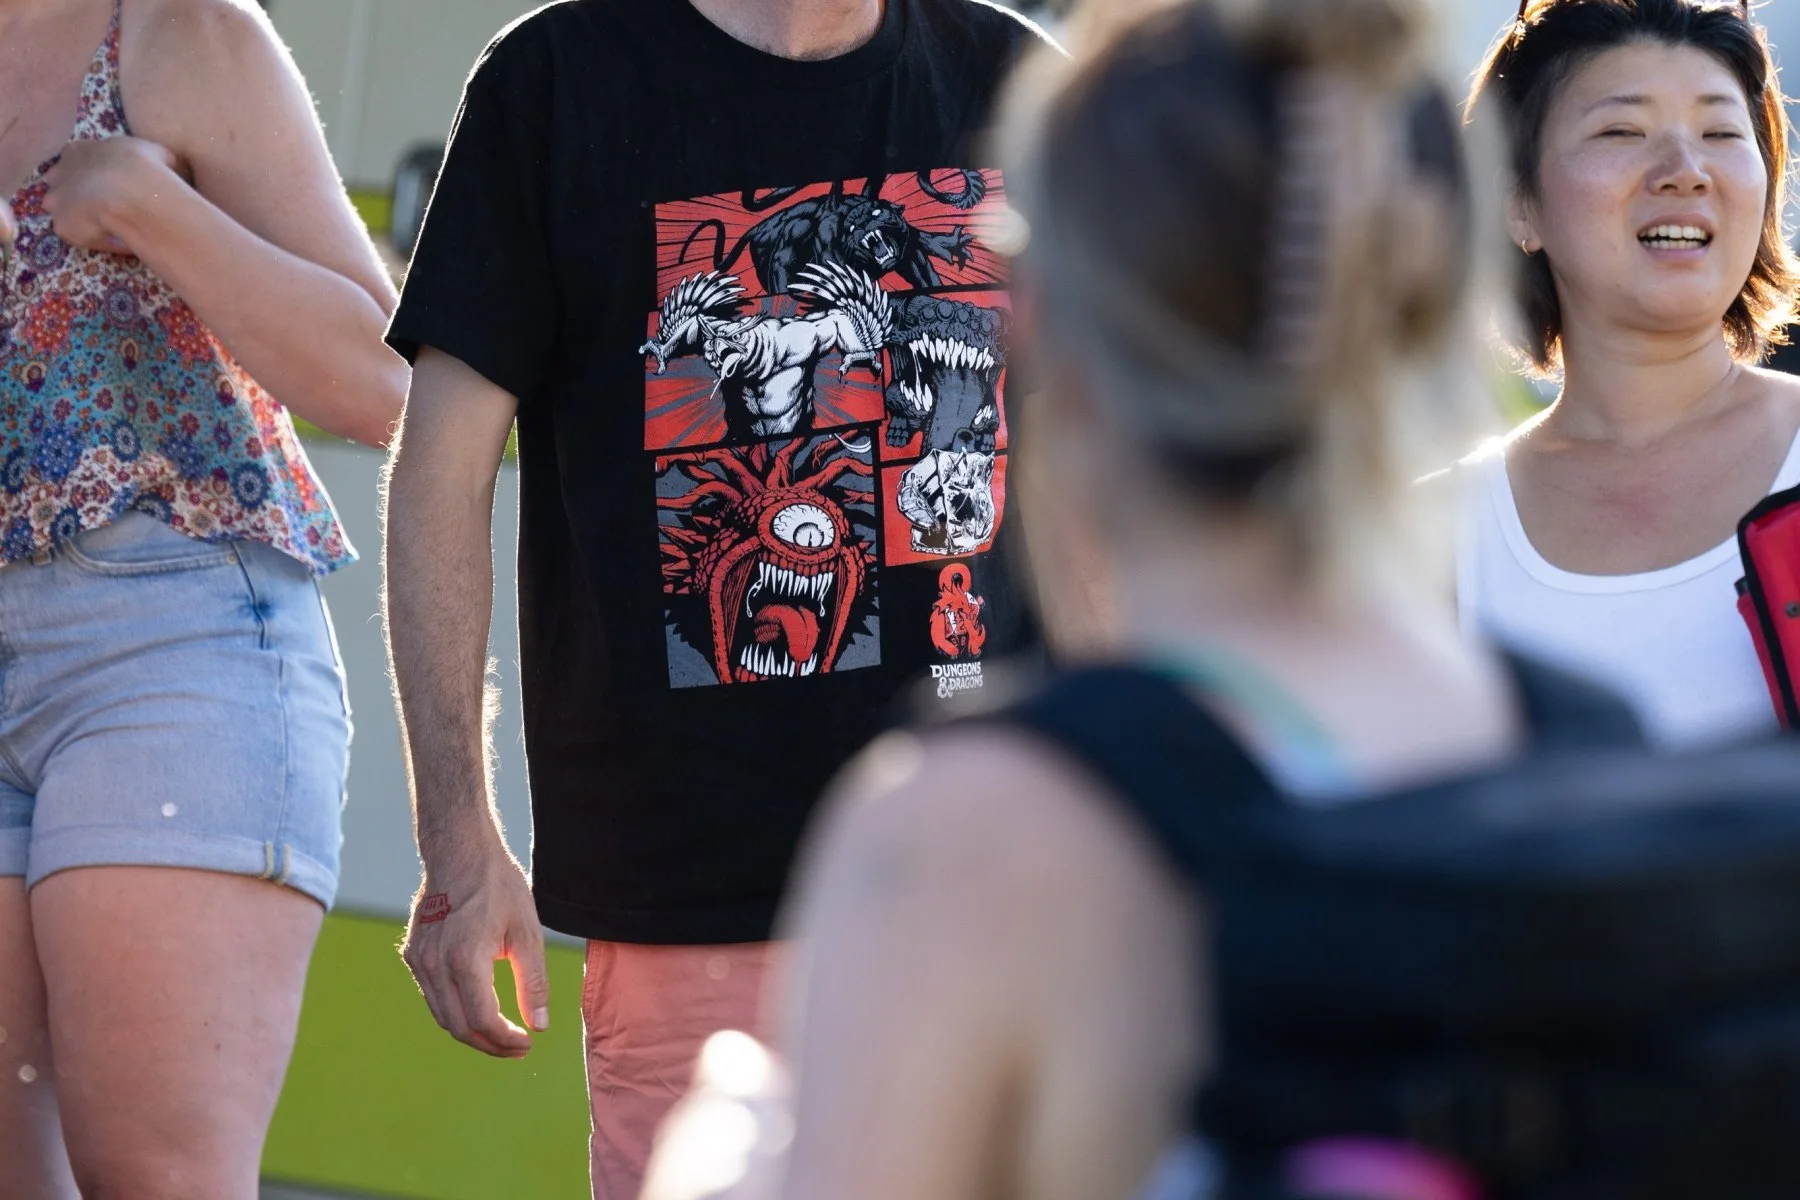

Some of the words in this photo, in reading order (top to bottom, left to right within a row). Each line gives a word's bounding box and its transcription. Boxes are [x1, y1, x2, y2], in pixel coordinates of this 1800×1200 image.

[930, 661, 982, 678] DUNGEONS
[937, 676, 954, 699] &
[948, 674, 984, 691] DRAGONS
